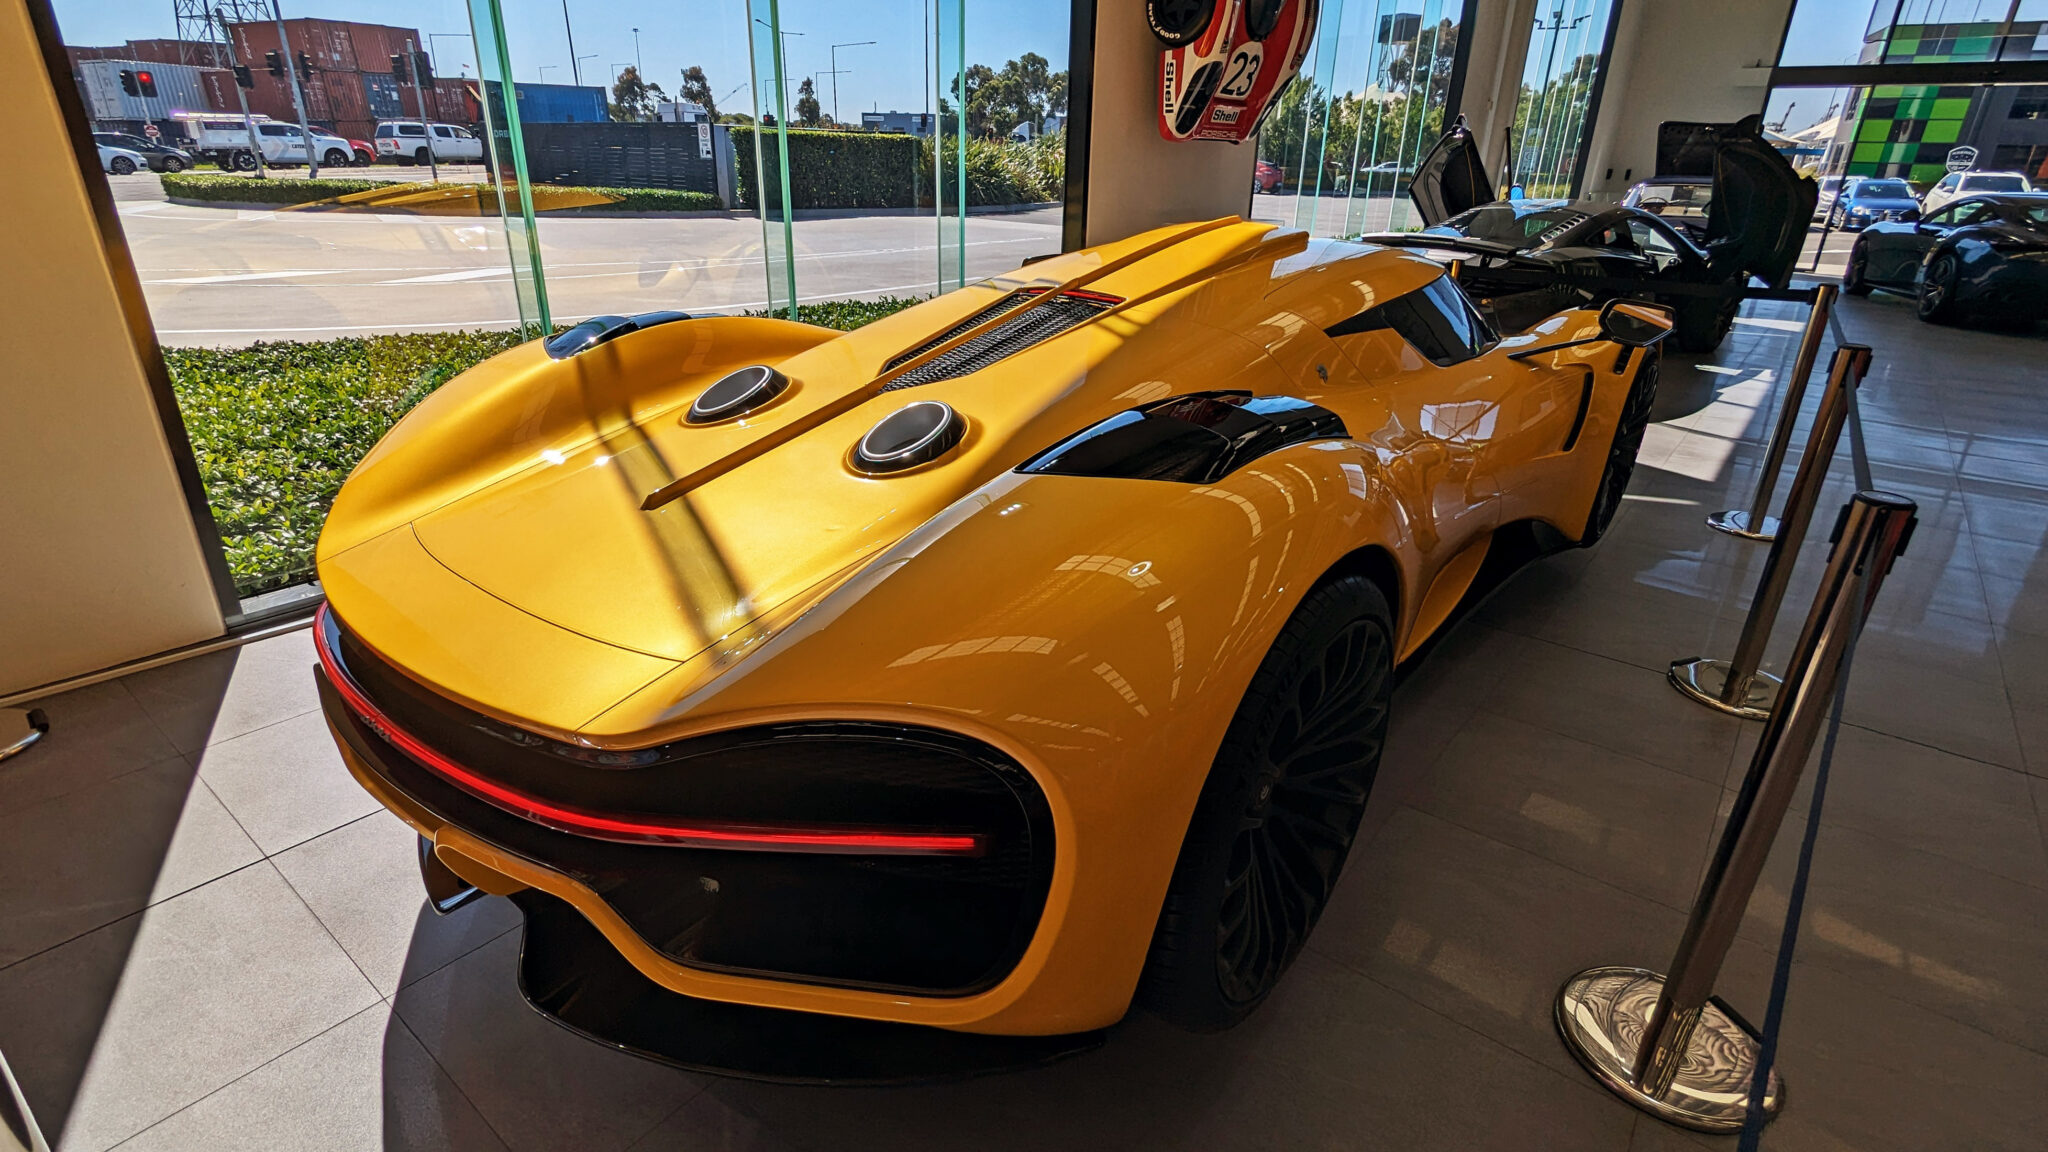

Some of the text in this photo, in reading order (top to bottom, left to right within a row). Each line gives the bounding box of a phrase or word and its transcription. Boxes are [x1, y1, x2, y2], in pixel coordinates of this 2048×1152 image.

[1165, 62, 1174, 114] Shell
[1220, 52, 1260, 96] 23
[1213, 110, 1239, 122] Shell
[1201, 129, 1238, 138] PORSCHE
